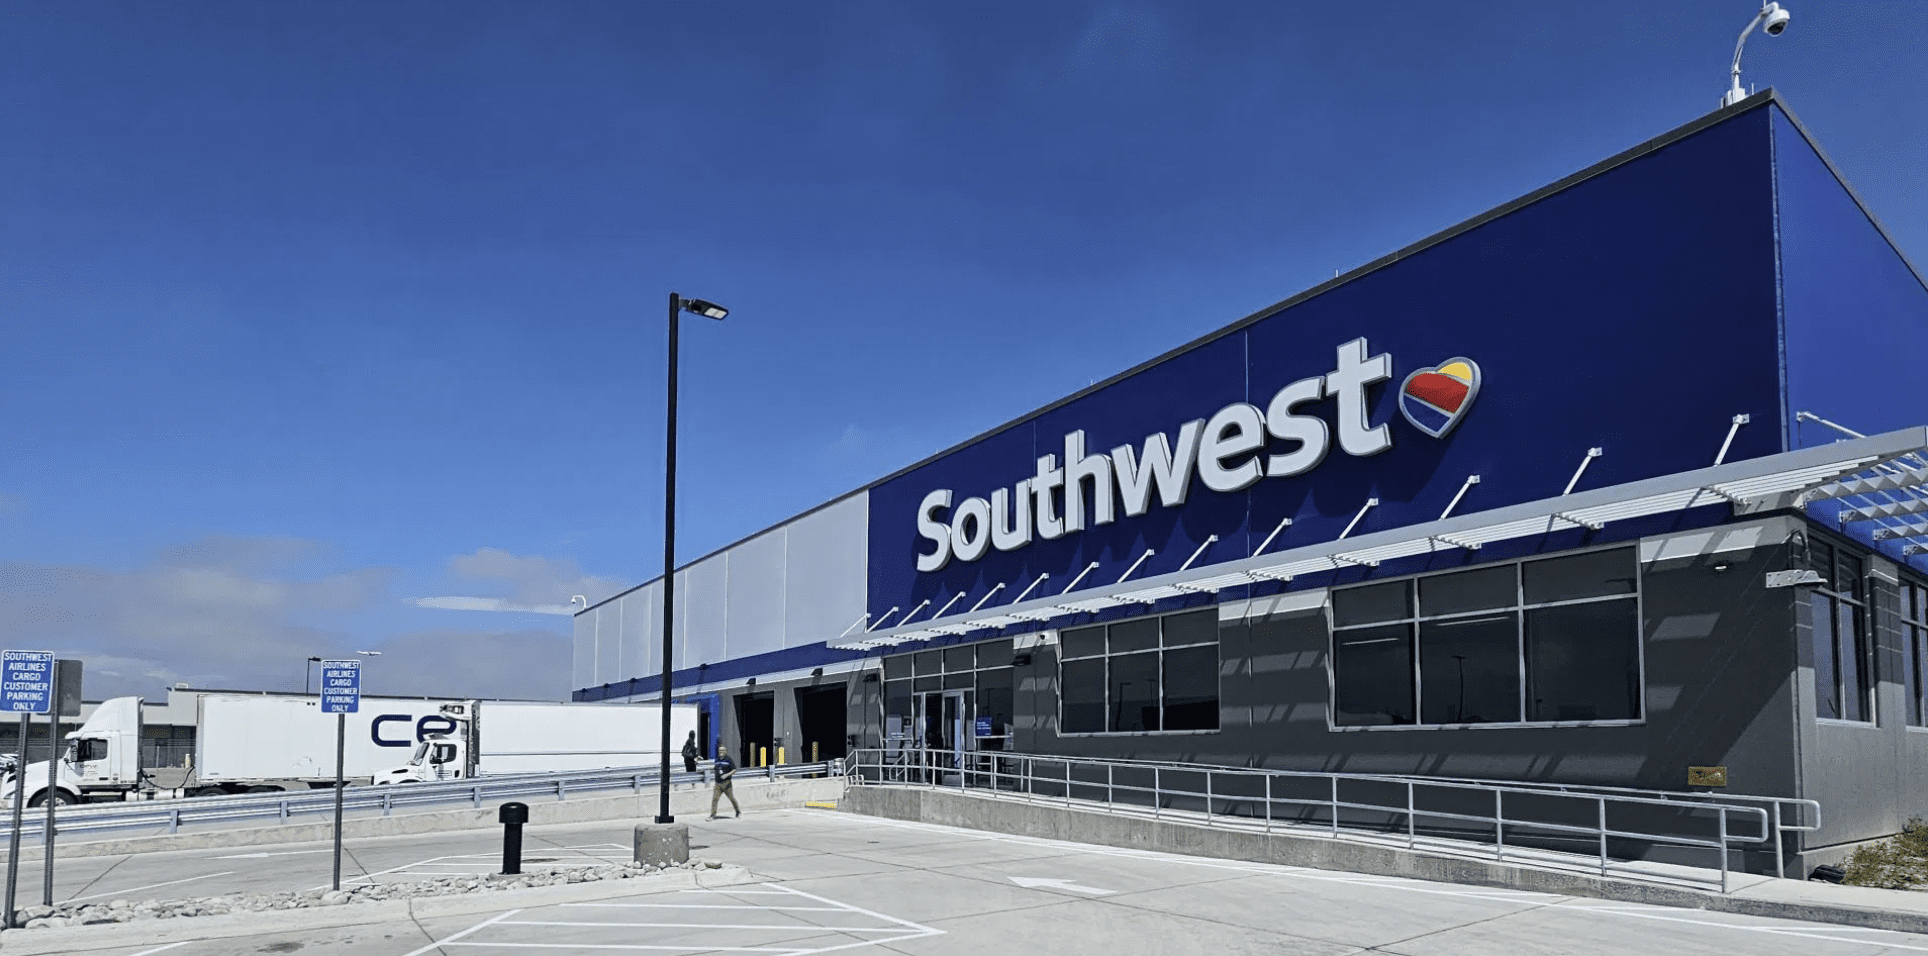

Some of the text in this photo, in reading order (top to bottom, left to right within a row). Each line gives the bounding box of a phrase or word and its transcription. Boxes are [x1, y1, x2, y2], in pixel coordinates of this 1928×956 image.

[916, 336, 1392, 572] Southwest
[4, 652, 52, 661] SOUTHWEST
[8, 662, 46, 671] AIRLINES
[12, 672, 41, 680] CARGO
[3, 682, 48, 691] CUSTOMER
[6, 691, 43, 701] PARKING
[13, 702, 35, 710] ONLY
